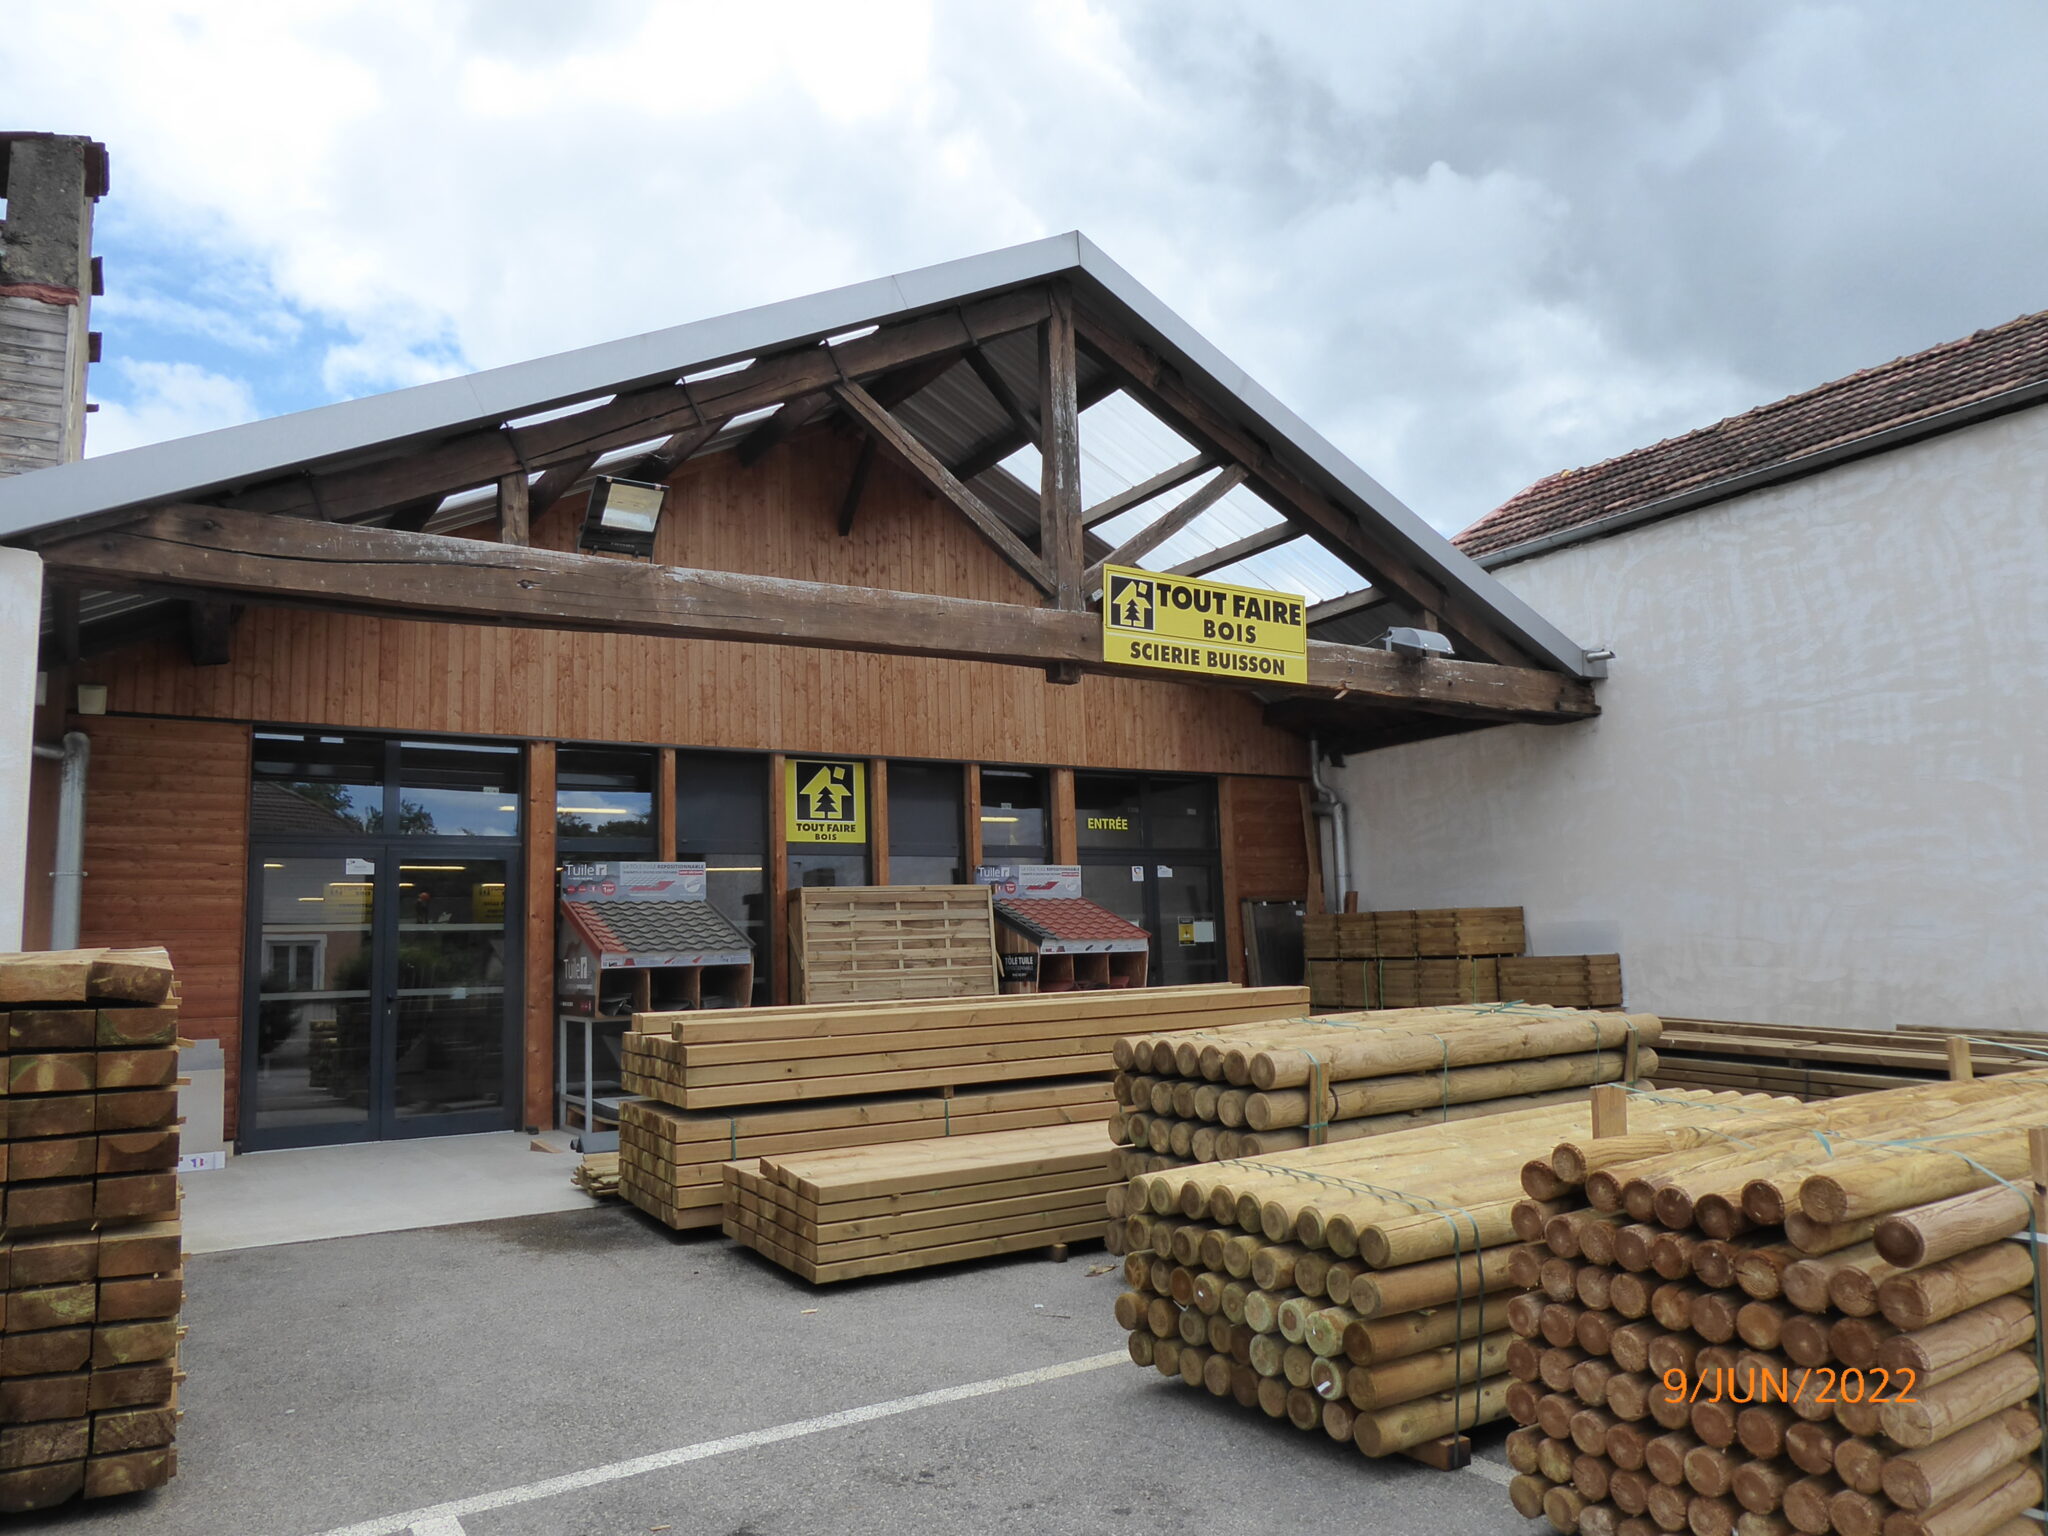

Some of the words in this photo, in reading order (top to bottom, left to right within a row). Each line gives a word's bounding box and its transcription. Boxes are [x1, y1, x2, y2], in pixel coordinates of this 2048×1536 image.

[1157, 582, 1227, 615] TOUT
[1233, 595, 1301, 627] FAIRE
[1203, 619, 1257, 644] BOIS
[1130, 641, 1200, 666] SCIERIE
[1207, 651, 1285, 676] BUISSON
[796, 823, 825, 832] TOUT
[827, 824, 856, 833] FAIRE
[1087, 816, 1129, 830] ENTRÉE
[565, 863, 595, 876] Tuile
[979, 866, 1000, 877] Tuile
